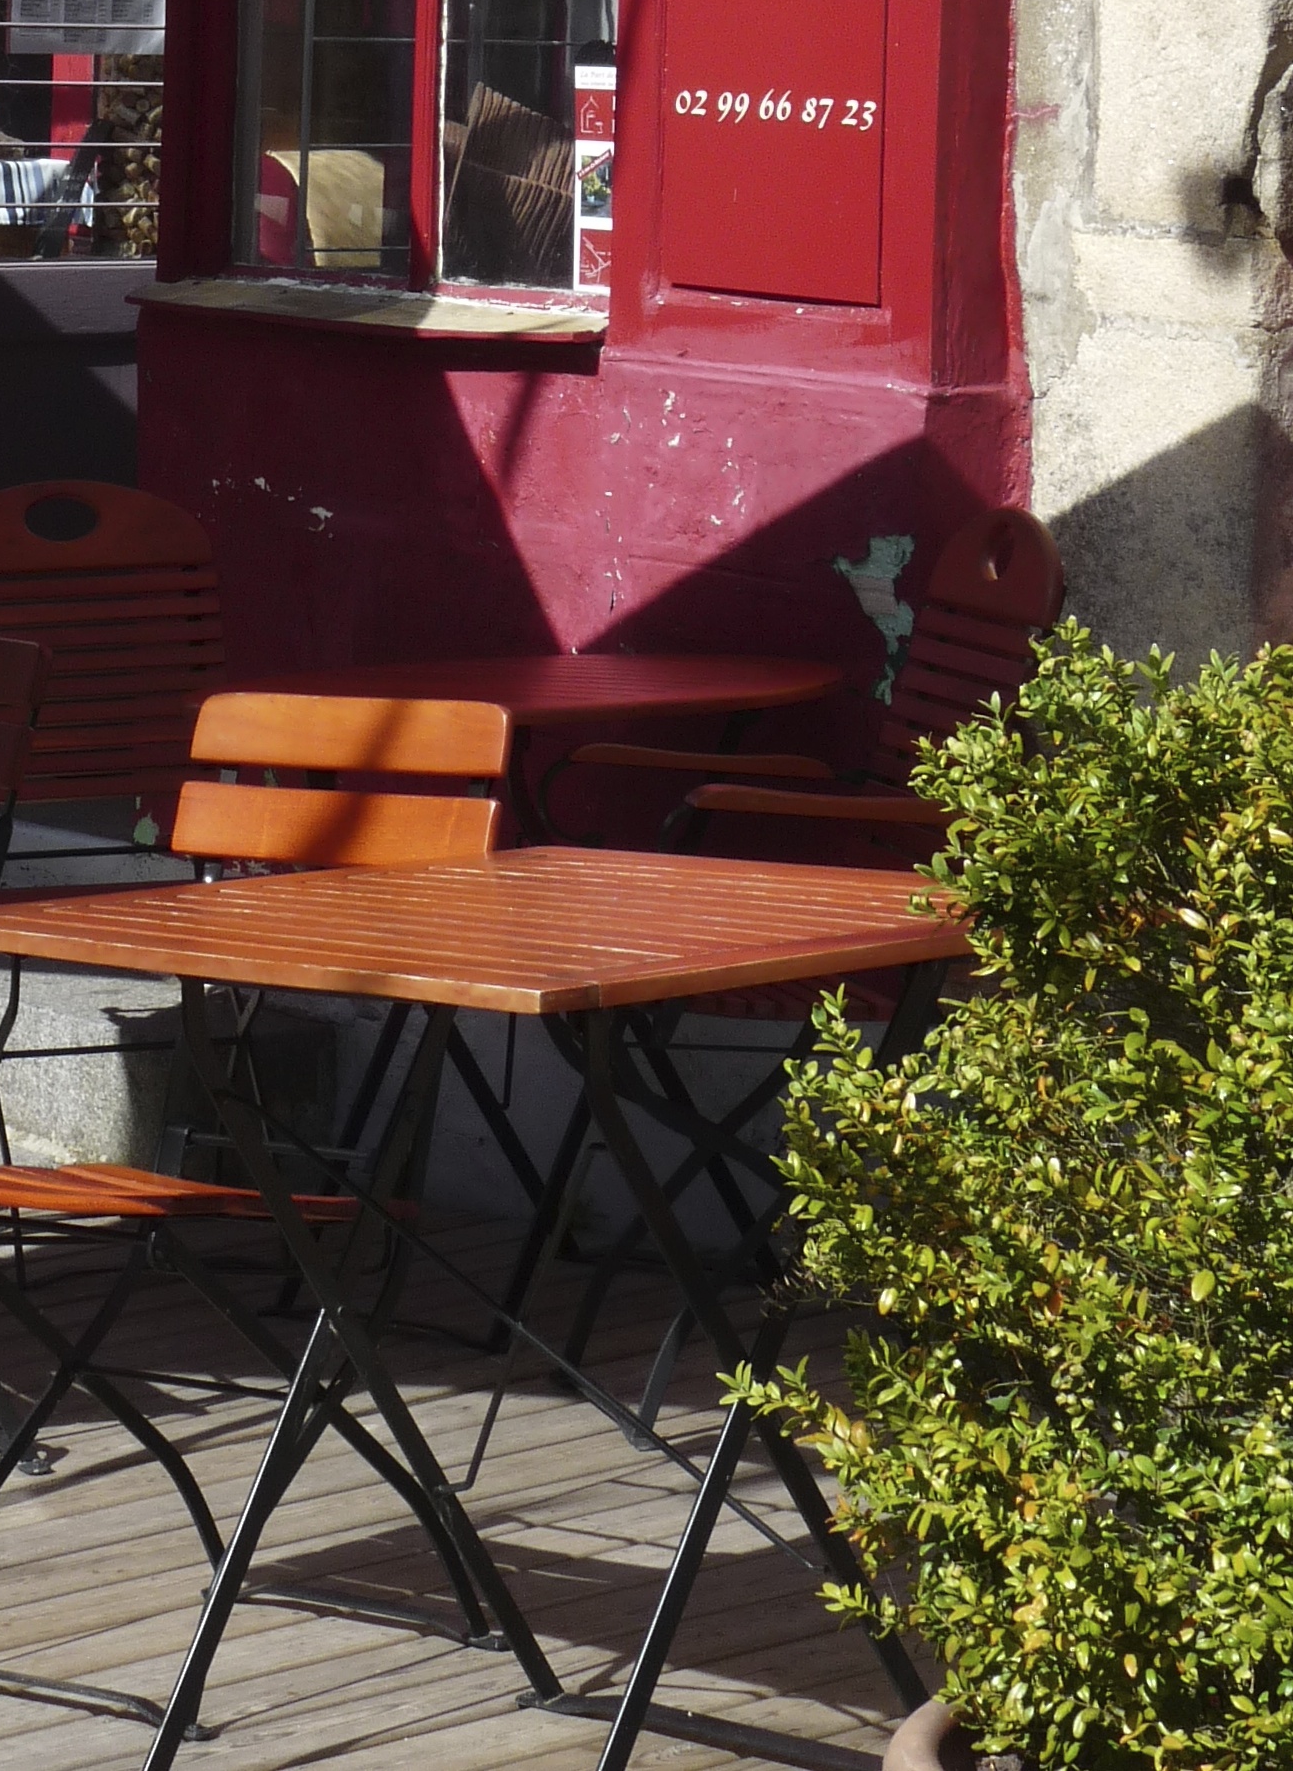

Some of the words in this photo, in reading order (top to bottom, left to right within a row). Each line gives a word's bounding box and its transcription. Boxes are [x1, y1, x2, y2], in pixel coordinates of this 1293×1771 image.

[675, 89, 708, 116] 02
[717, 91, 750, 124] 99
[758, 88, 792, 121] 66
[801, 97, 834, 129] 87
[841, 99, 877, 131] 23
